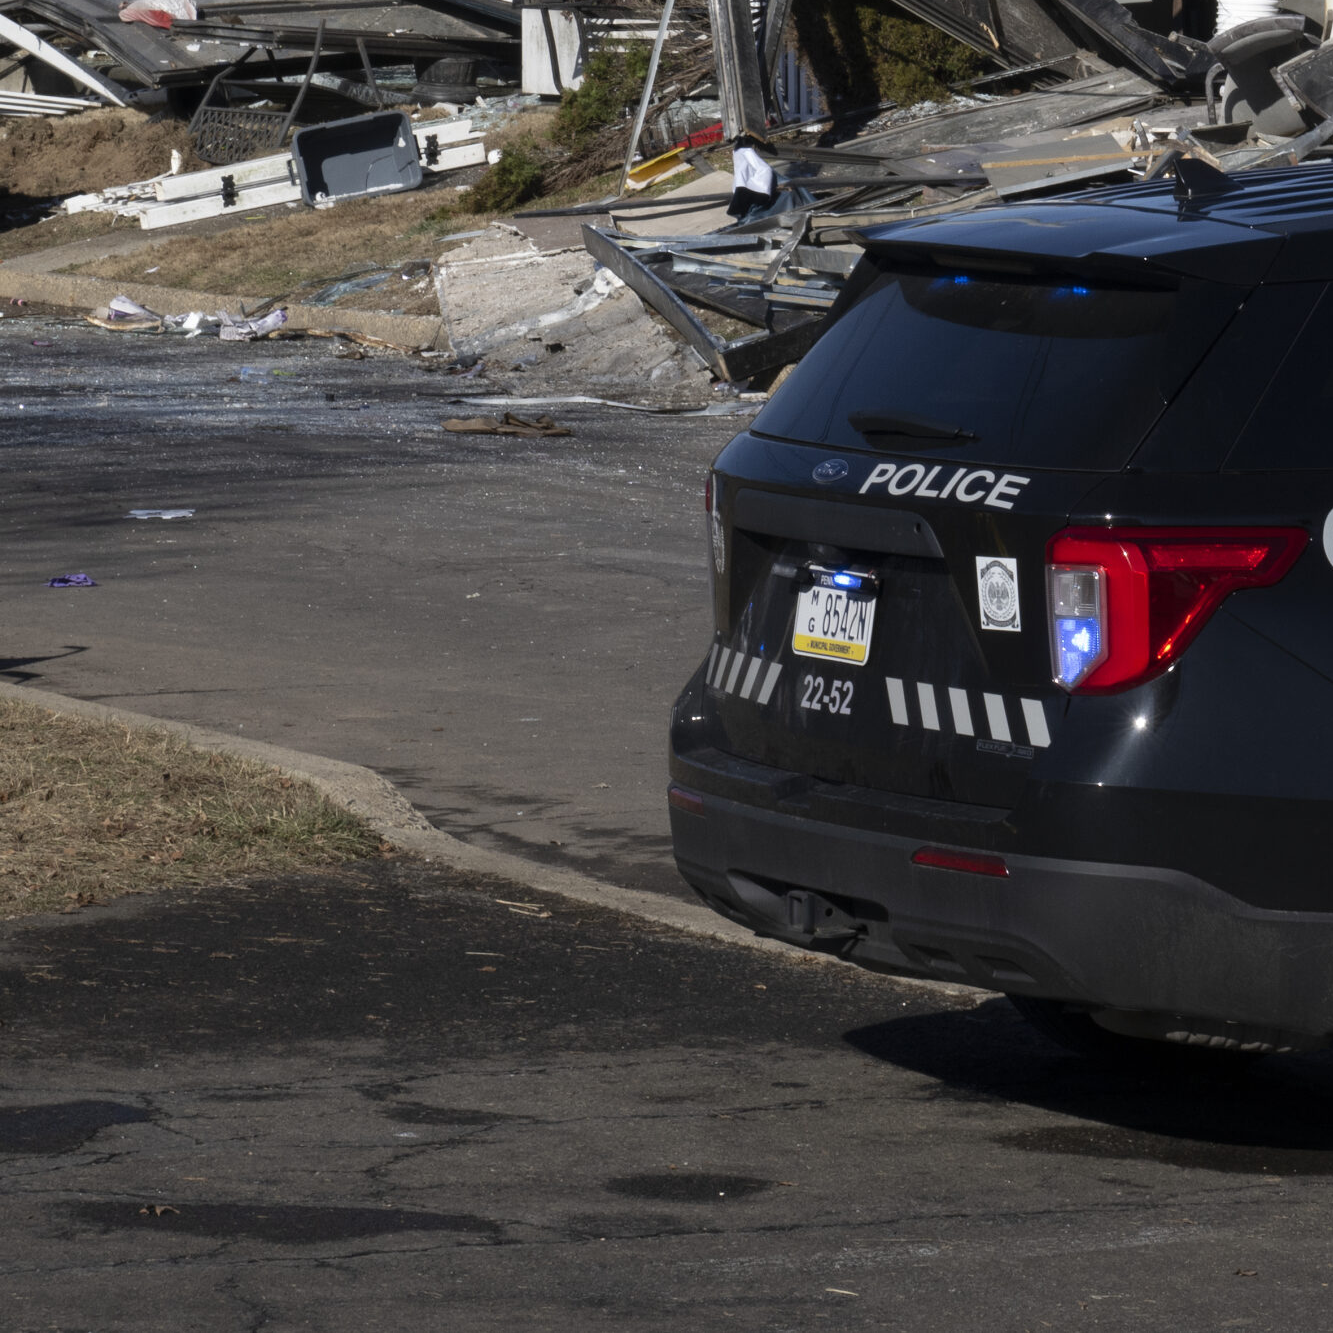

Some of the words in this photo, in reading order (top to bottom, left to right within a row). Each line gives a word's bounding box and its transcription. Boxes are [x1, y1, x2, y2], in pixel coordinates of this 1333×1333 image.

[858, 463, 1031, 510] POLICE
[811, 589, 820, 606] M
[822, 593, 868, 641] 8542N
[808, 617, 816, 633] G
[800, 675, 854, 715] 22-52
